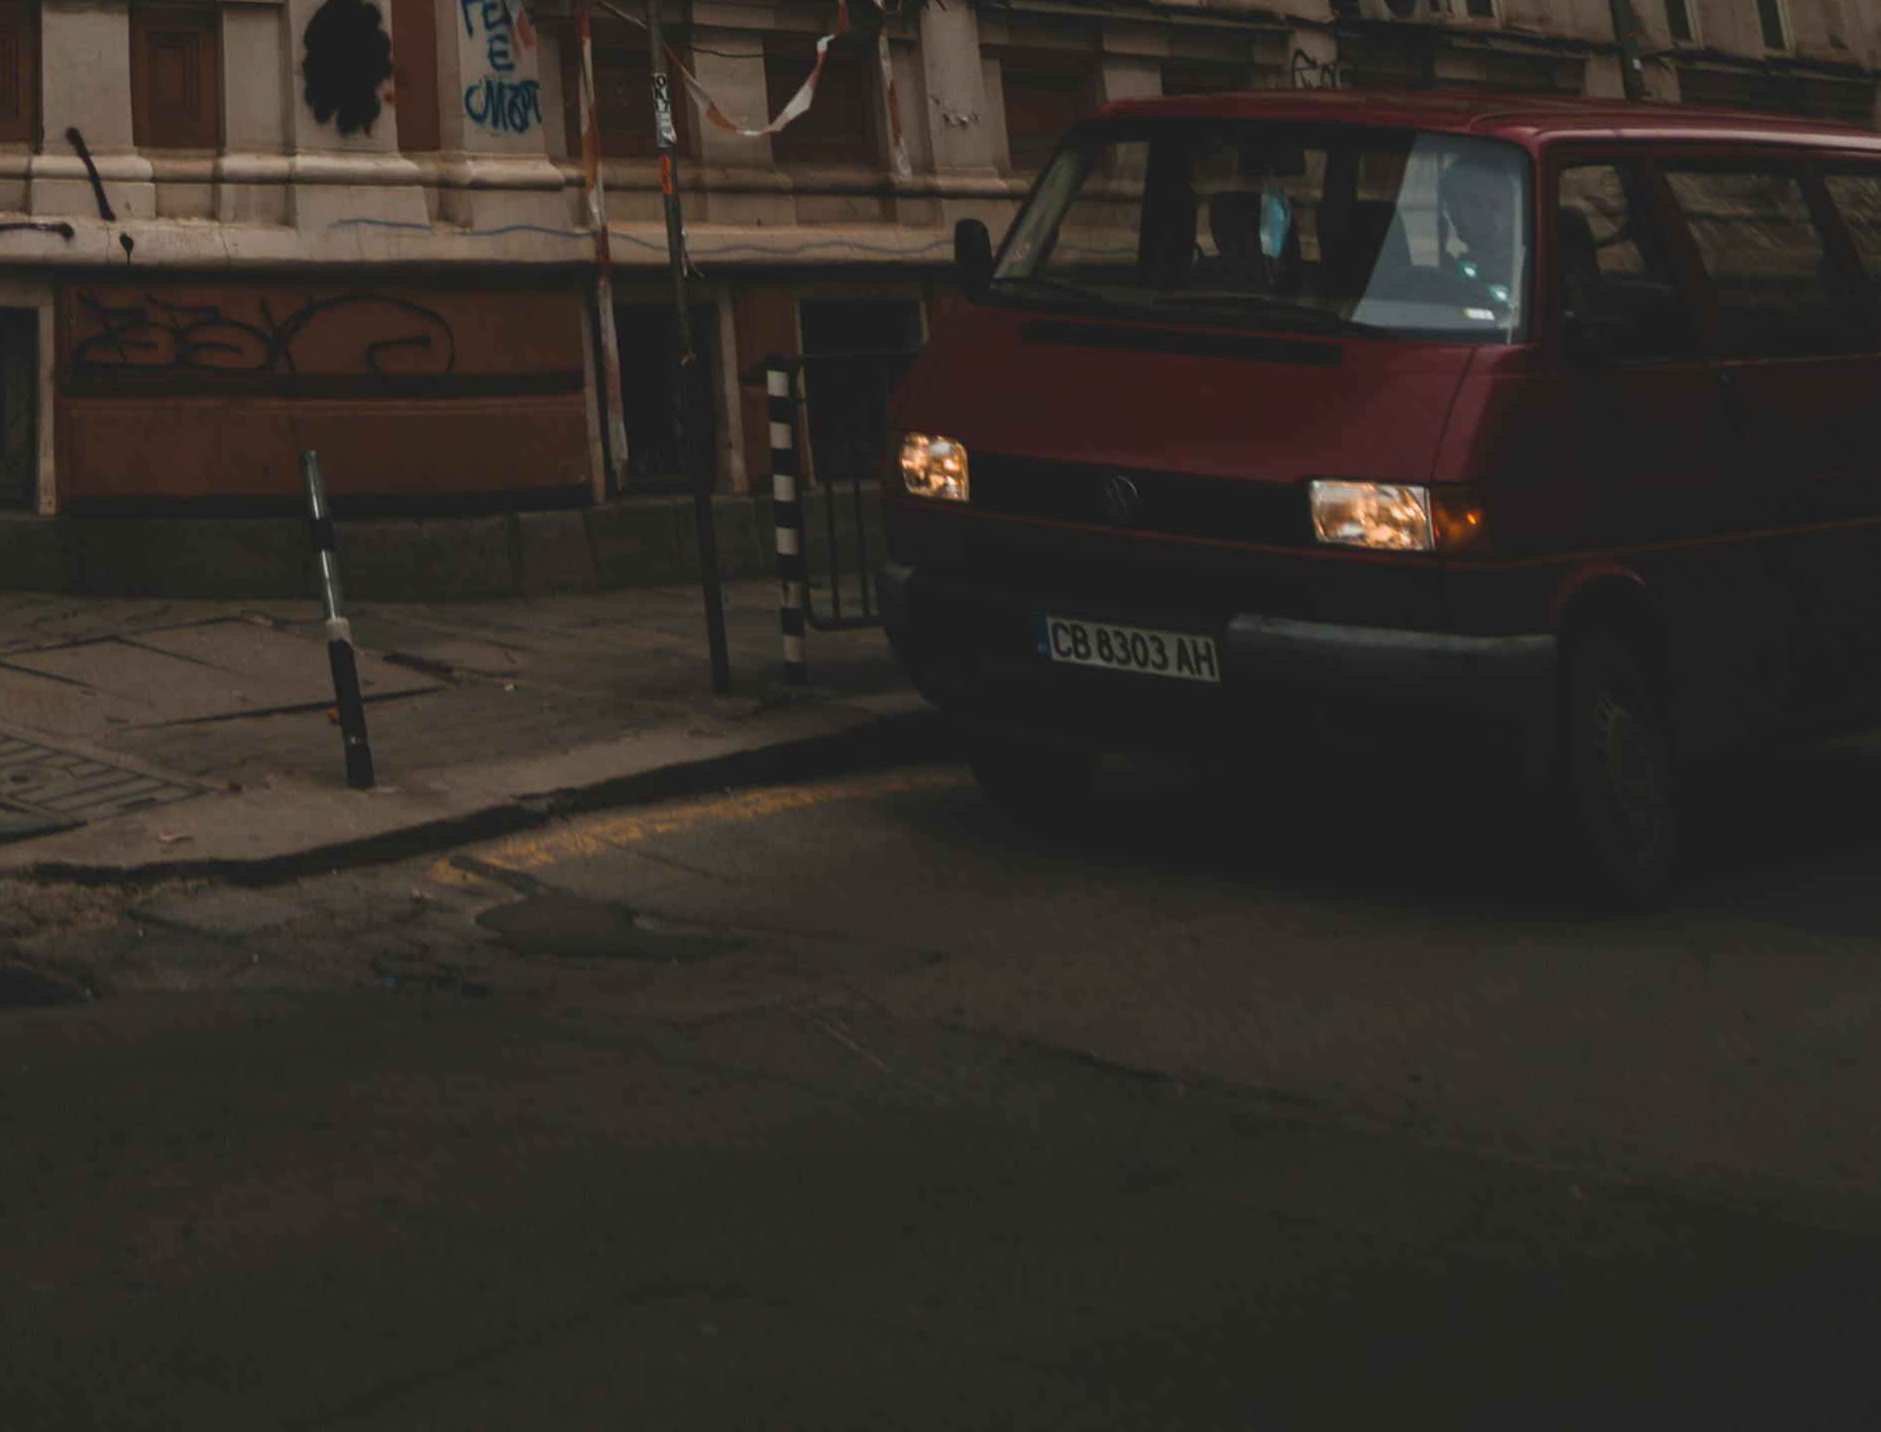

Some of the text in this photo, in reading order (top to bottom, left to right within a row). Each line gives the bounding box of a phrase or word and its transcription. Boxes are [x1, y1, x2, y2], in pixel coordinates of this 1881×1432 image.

[1052, 622, 1215, 678] CB 8303 AH
